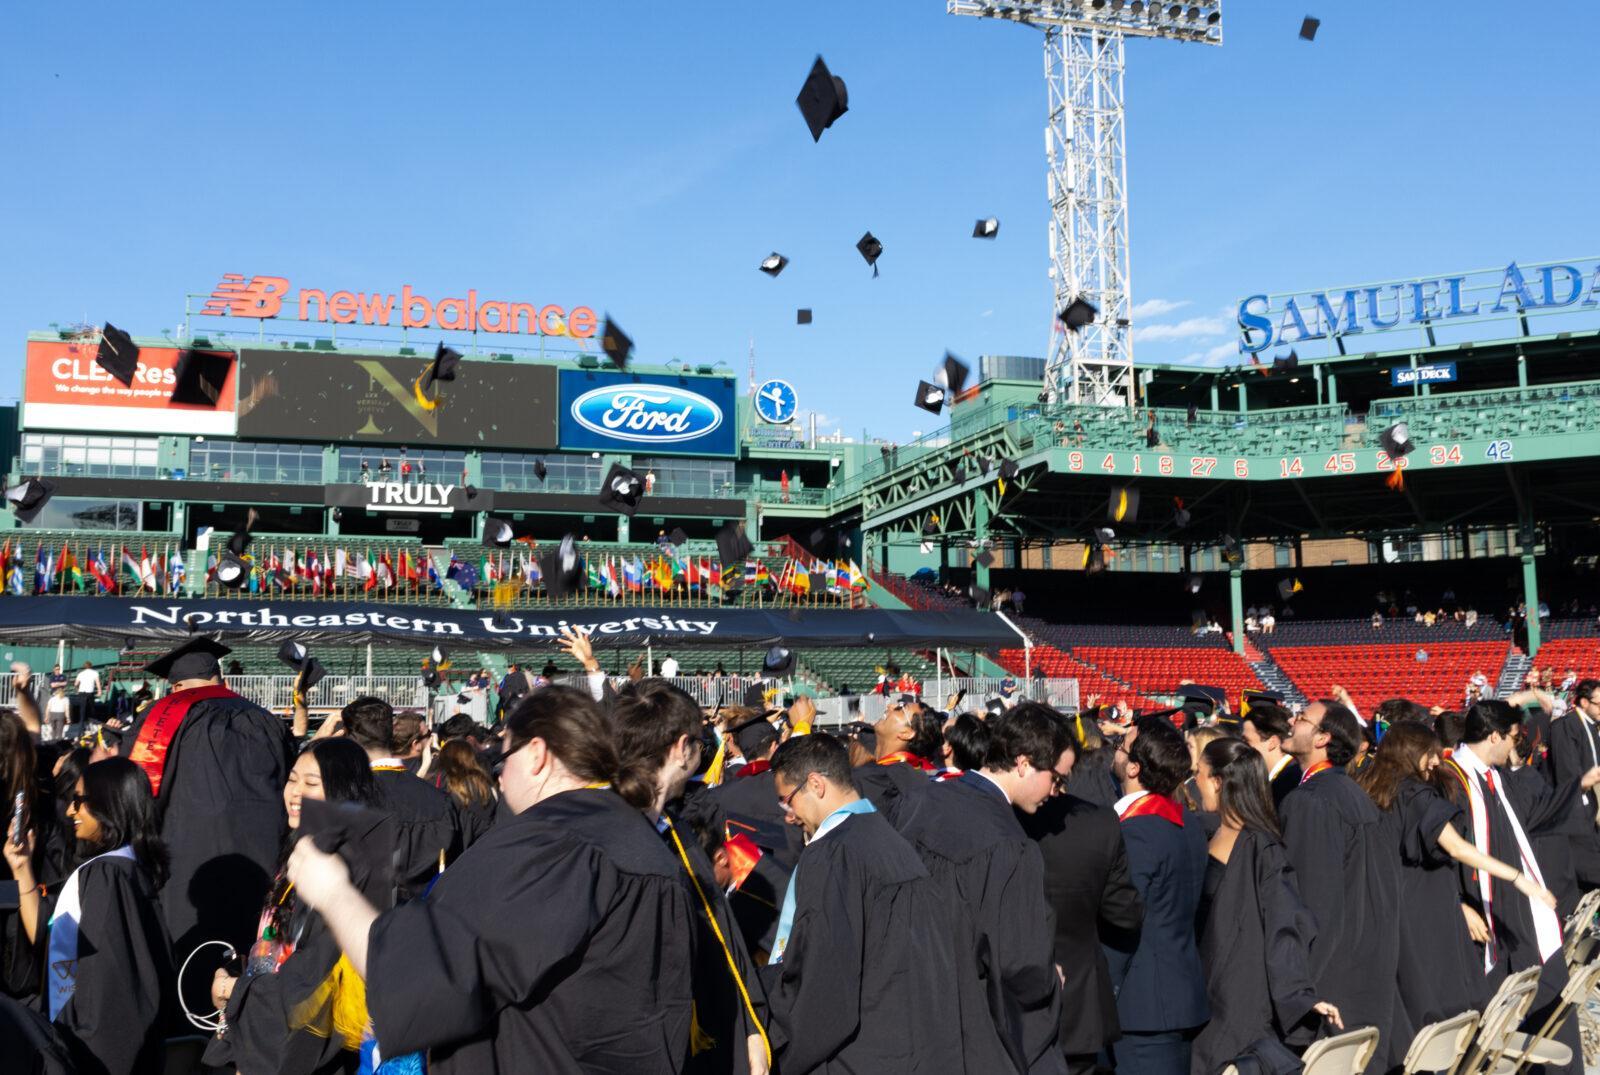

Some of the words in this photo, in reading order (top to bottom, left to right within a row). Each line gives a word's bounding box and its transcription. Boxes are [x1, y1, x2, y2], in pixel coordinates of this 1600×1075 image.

[299, 288, 396, 325] new
[402, 285, 598, 338] balance
[1237, 277, 1480, 354] SAMUEL
[52, 358, 177, 384] CLERes
[1421, 368, 1451, 379] DECK
[55, 384, 69, 392] We
[71, 385, 100, 395] change
[102, 386, 115, 394] the
[133, 389, 161, 397] people
[602, 391, 693, 433] Ford
[1069, 452, 1083, 472] 9
[1102, 454, 1115, 473] 4
[1134, 454, 1142, 474] 1
[1159, 456, 1174, 476] 8
[1190, 457, 1217, 477] 27
[1234, 459, 1249, 478] 6
[1280, 456, 1304, 478] 14
[1324, 453, 1356, 473] 45
[1430, 445, 1463, 465] 34
[1487, 440, 1512, 461] 42
[366, 481, 455, 505] TRULY
[130, 605, 465, 635] Northeastern
[479, 615, 718, 635] University
